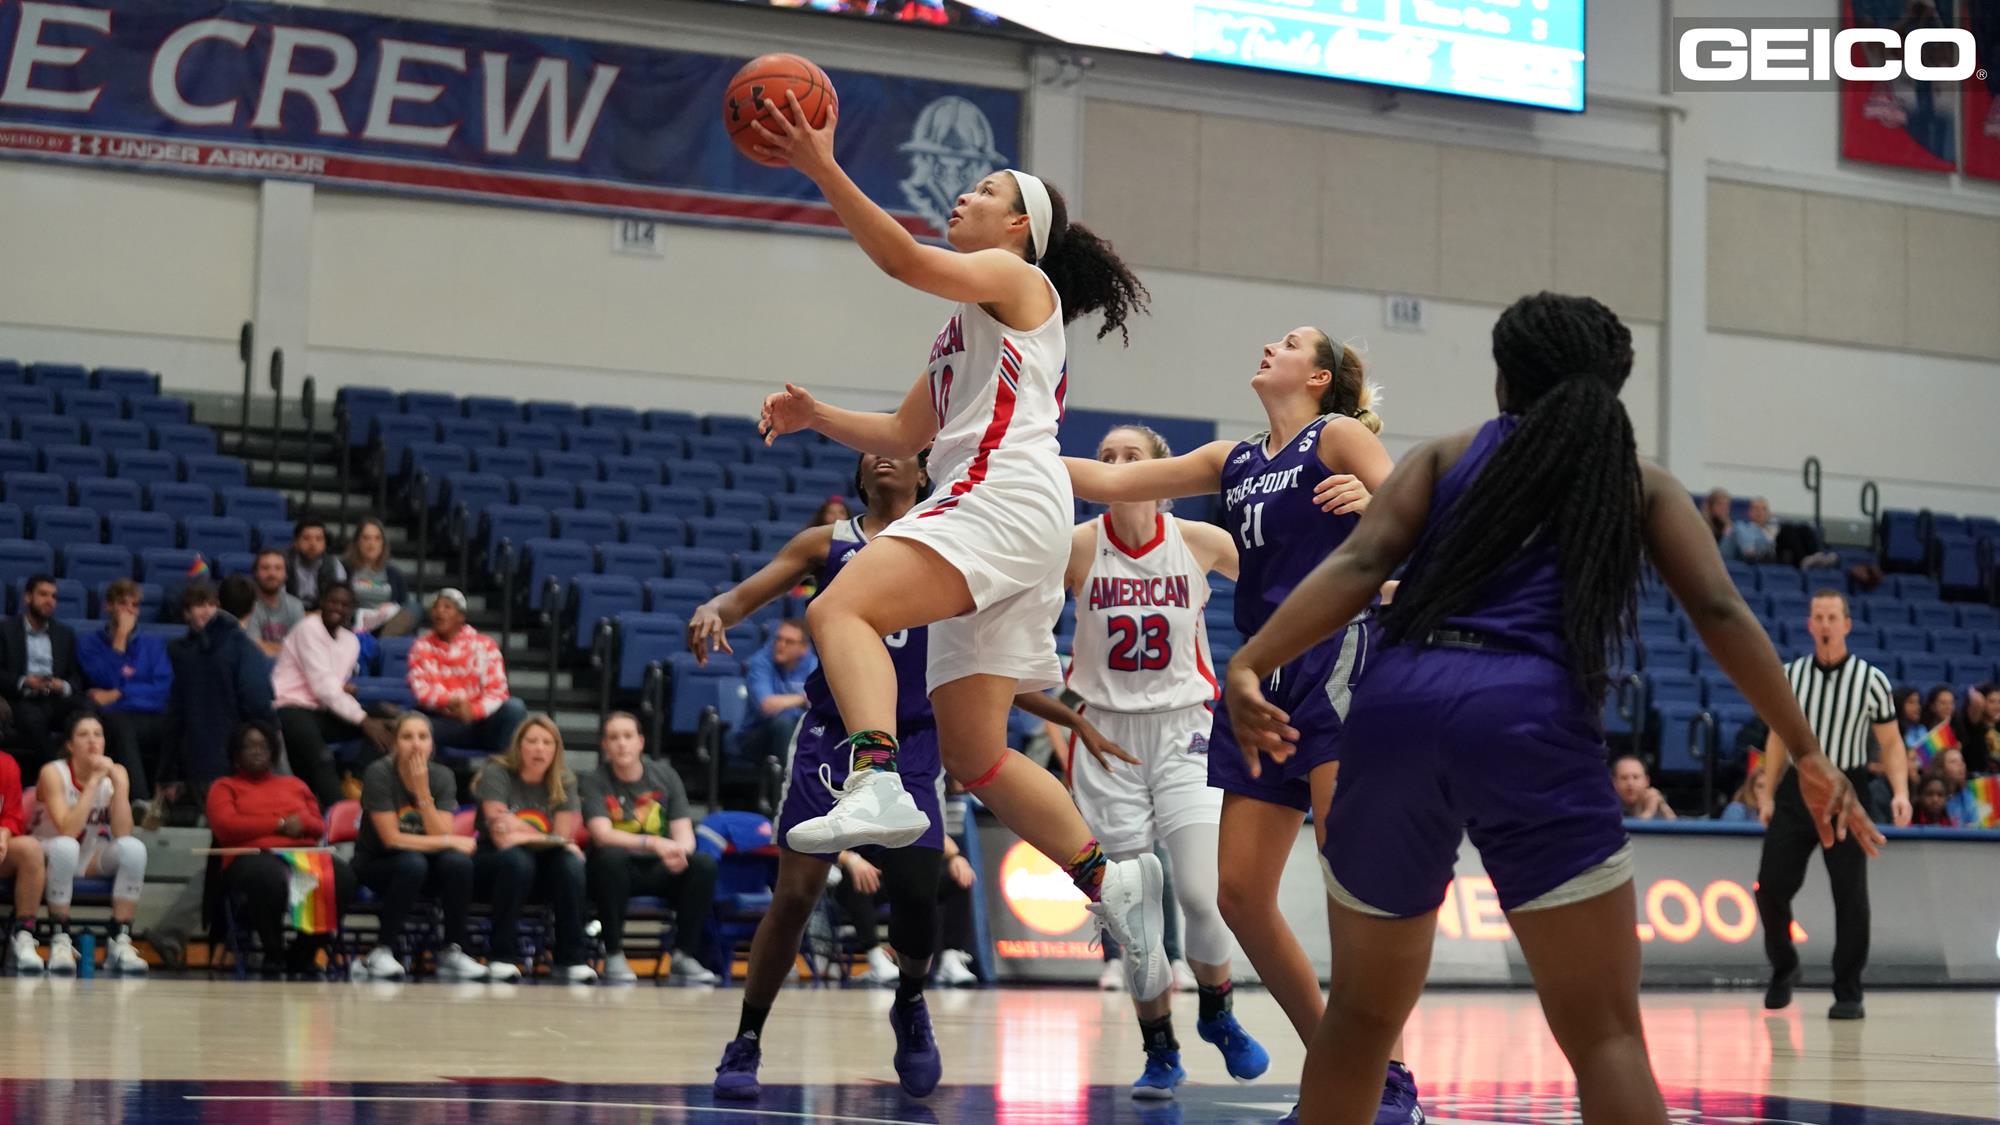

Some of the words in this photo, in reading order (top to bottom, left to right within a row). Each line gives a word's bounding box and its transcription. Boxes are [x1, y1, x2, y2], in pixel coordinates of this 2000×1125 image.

[151, 18, 620, 161] CREW
[108, 137, 200, 163] UNDER
[208, 148, 326, 174] ARMOUR
[1249, 464, 1304, 494] POINT
[1240, 502, 1265, 549] 21
[1089, 575, 1189, 611] AMERICAN
[1107, 613, 1172, 671] 23
